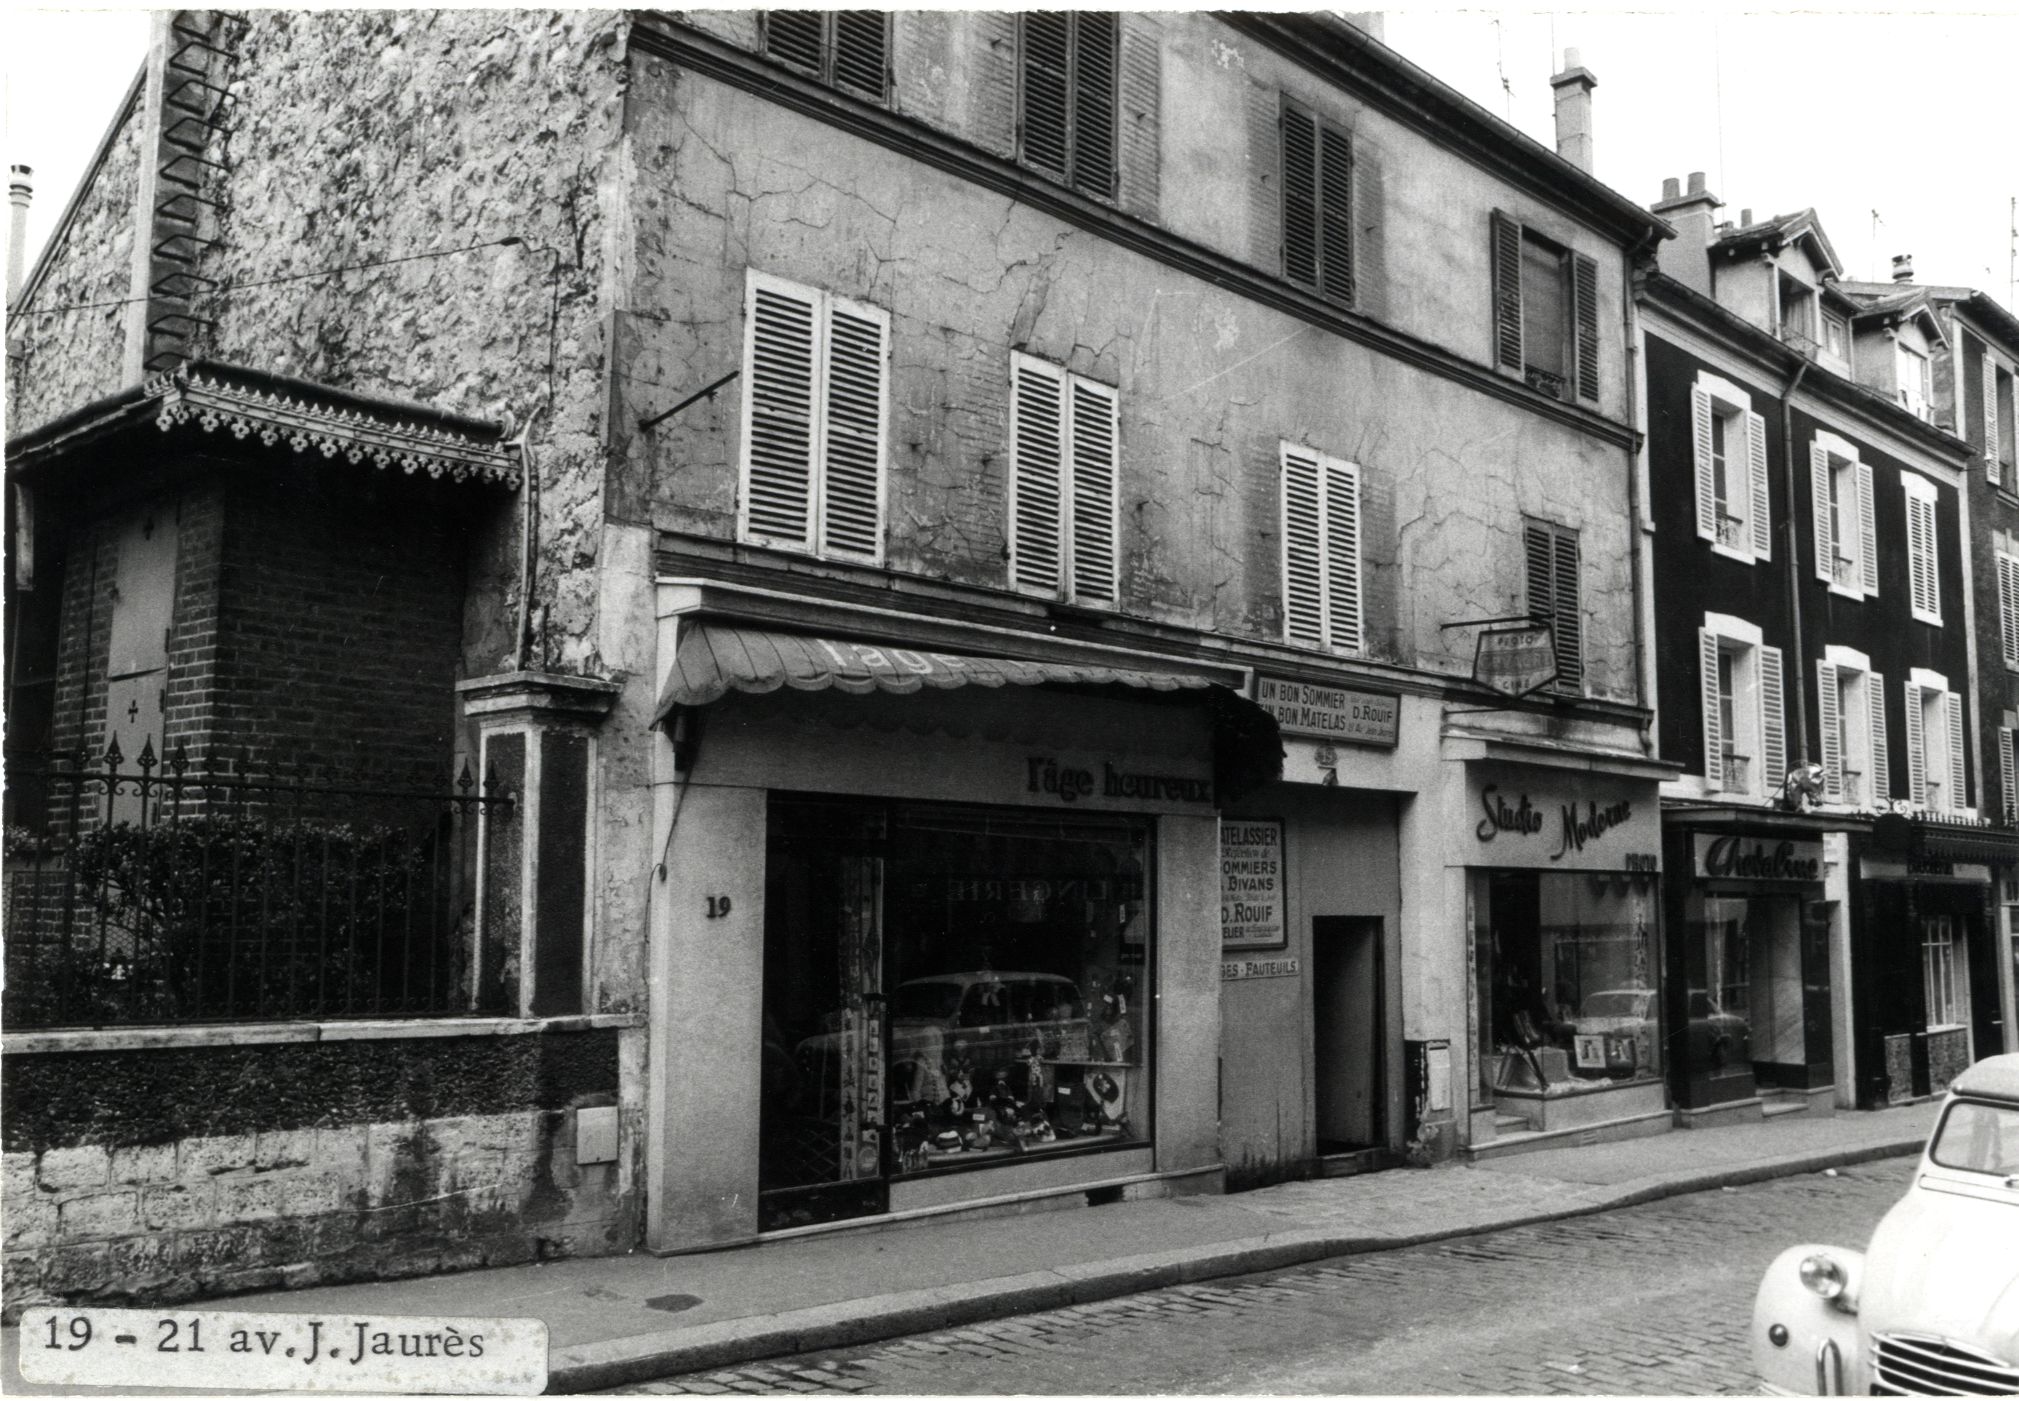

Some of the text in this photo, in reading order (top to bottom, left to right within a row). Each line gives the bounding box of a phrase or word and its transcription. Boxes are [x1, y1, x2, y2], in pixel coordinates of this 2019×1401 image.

[1262, 681, 1276, 699] UN
[1280, 684, 1300, 703] BON
[1302, 685, 1345, 710] SOMMIER
[1279, 706, 1298, 725] BON
[1300, 707, 1346, 731] MATELAS
[1476, 784, 1632, 861] Studio Moderne
[1220, 826, 1278, 846] ATELASSIER
[1220, 860, 1277, 875] OMMIERS
[706, 896, 732, 919] 19
[1221, 926, 1245, 939] ELIER
[1245, 960, 1297, 977] FAUTEUILS
